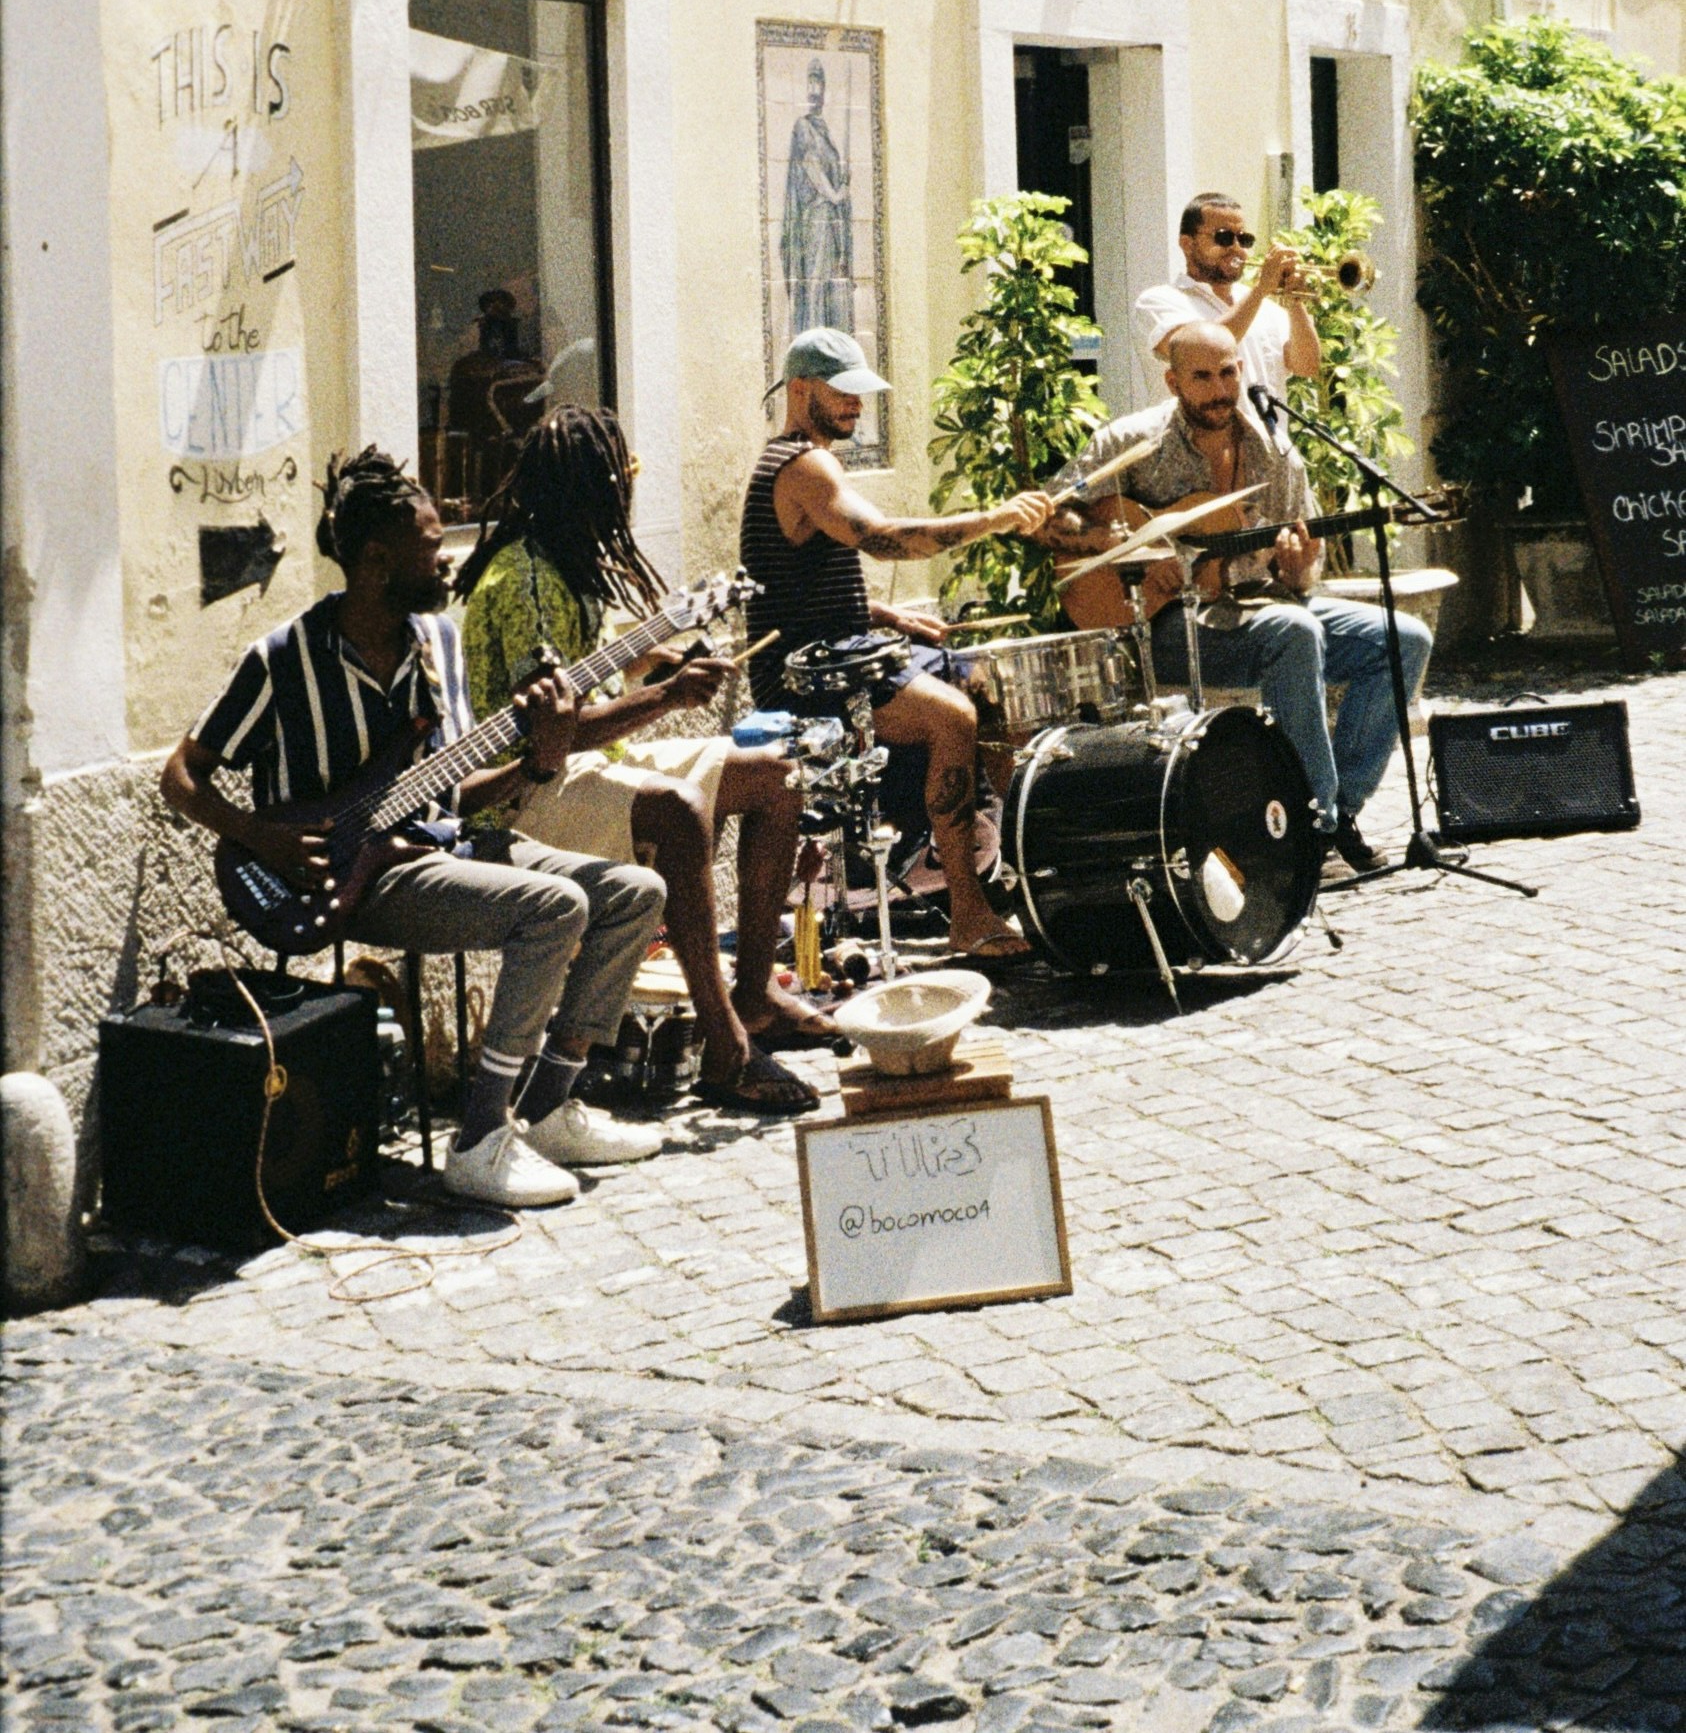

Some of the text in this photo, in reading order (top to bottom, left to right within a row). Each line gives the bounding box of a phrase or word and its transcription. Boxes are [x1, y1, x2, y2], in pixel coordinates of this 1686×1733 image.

[151, 23, 292, 131] THIS IS
[162, 353, 297, 453] CENTER
[1489, 720, 1572, 742] CUBE
